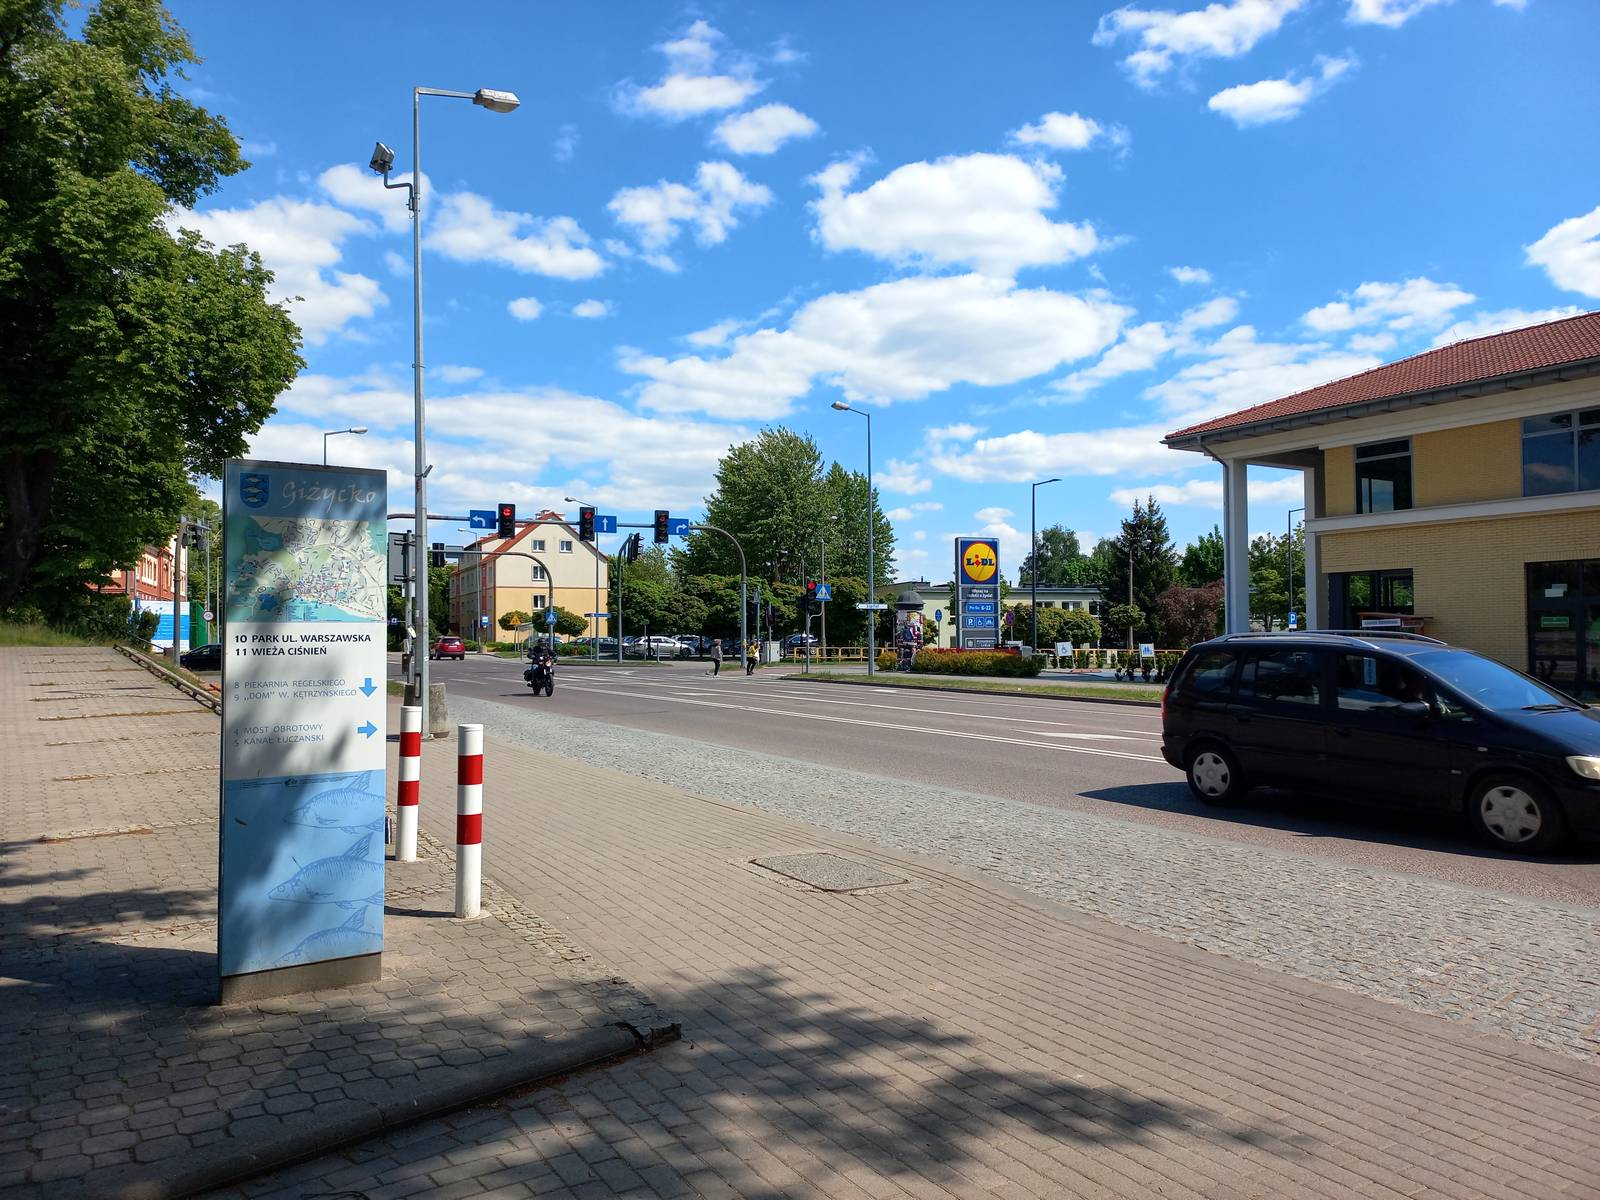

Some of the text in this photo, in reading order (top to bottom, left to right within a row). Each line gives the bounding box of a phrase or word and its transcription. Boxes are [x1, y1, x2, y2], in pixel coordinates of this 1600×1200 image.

[280, 480, 377, 514] Giżycko
[235, 634, 372, 644] 10 PARK UL. WARSZAWSKA
[235, 645, 327, 656] 11 WIEŻA CIŚNIEŃ
[234, 679, 346, 689] 8 PIEKARNIA REGELSKIEGO
[234, 694, 240, 702] 9
[278, 690, 290, 699] W.
[293, 689, 357, 700] KĘTRZYŃSKIEGO
[243, 726, 269, 735] MOST
[273, 723, 323, 733] OBROTOWY
[243, 736, 274, 745] KANAŁ
[277, 734, 325, 744] ŁUCZAŃSKI
